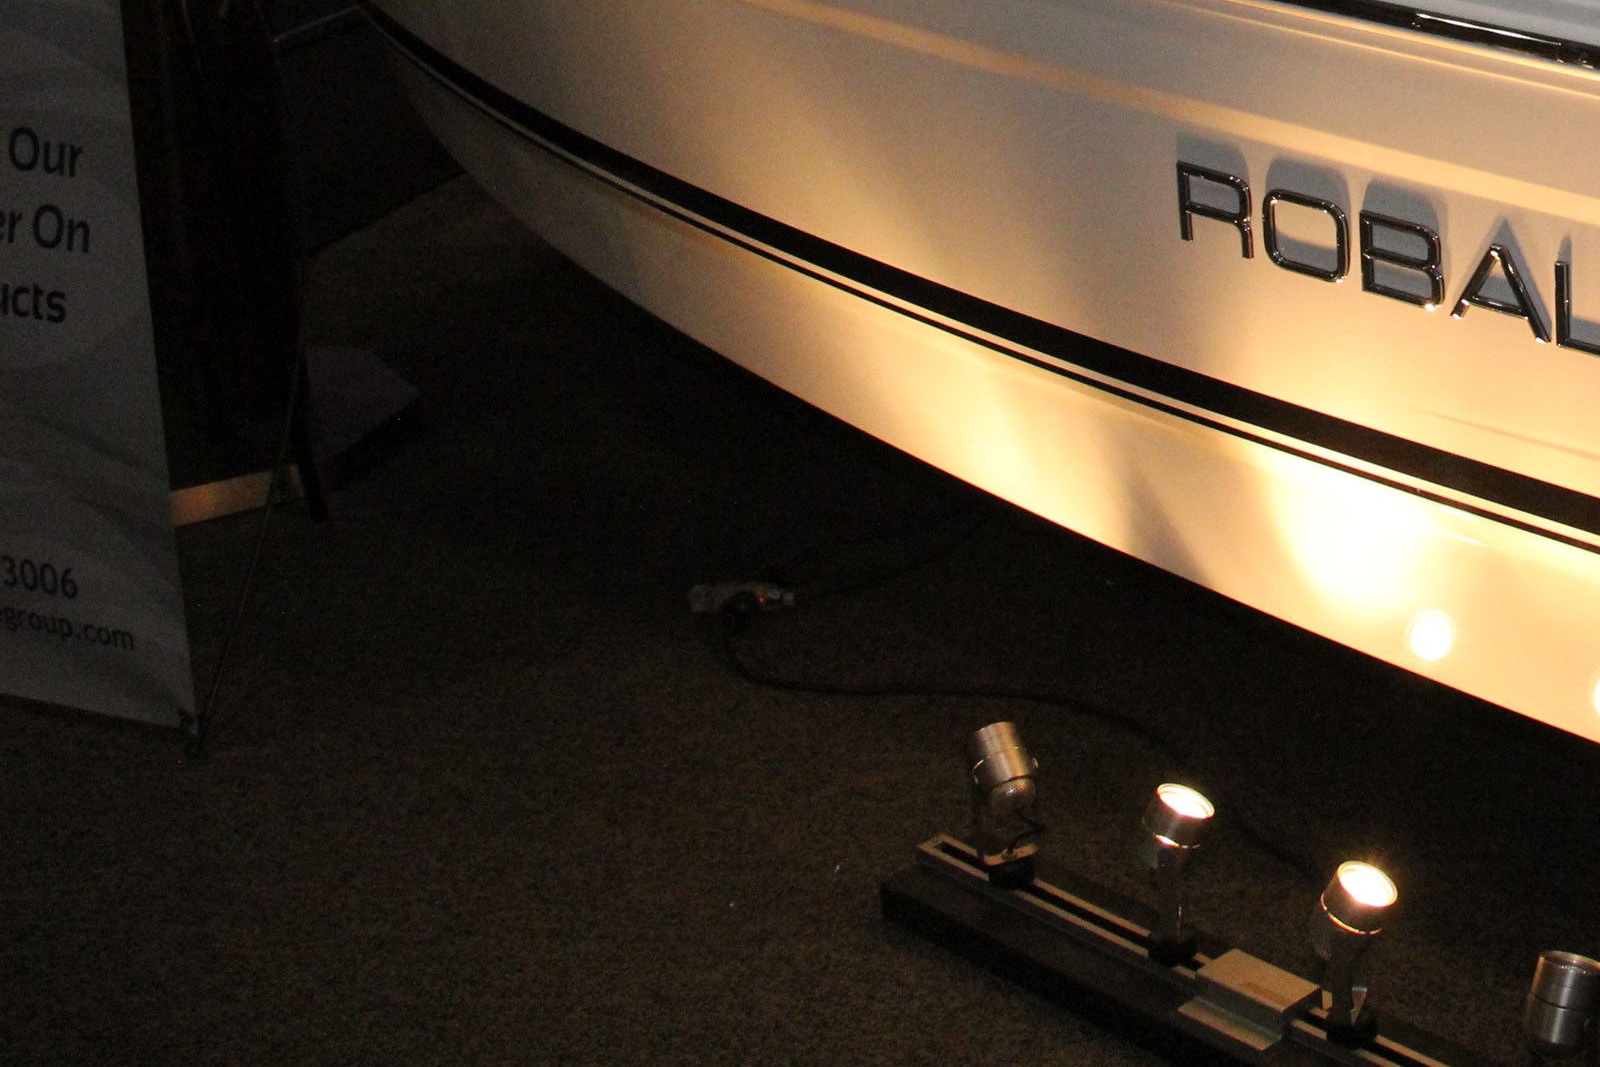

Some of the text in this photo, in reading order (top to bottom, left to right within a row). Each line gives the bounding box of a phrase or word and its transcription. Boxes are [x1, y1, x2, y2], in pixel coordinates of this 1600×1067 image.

[8, 126, 84, 178] Our
[32, 204, 91, 254] On
[0, 554, 78, 600] 3006
[0, 605, 136, 652] group.com
